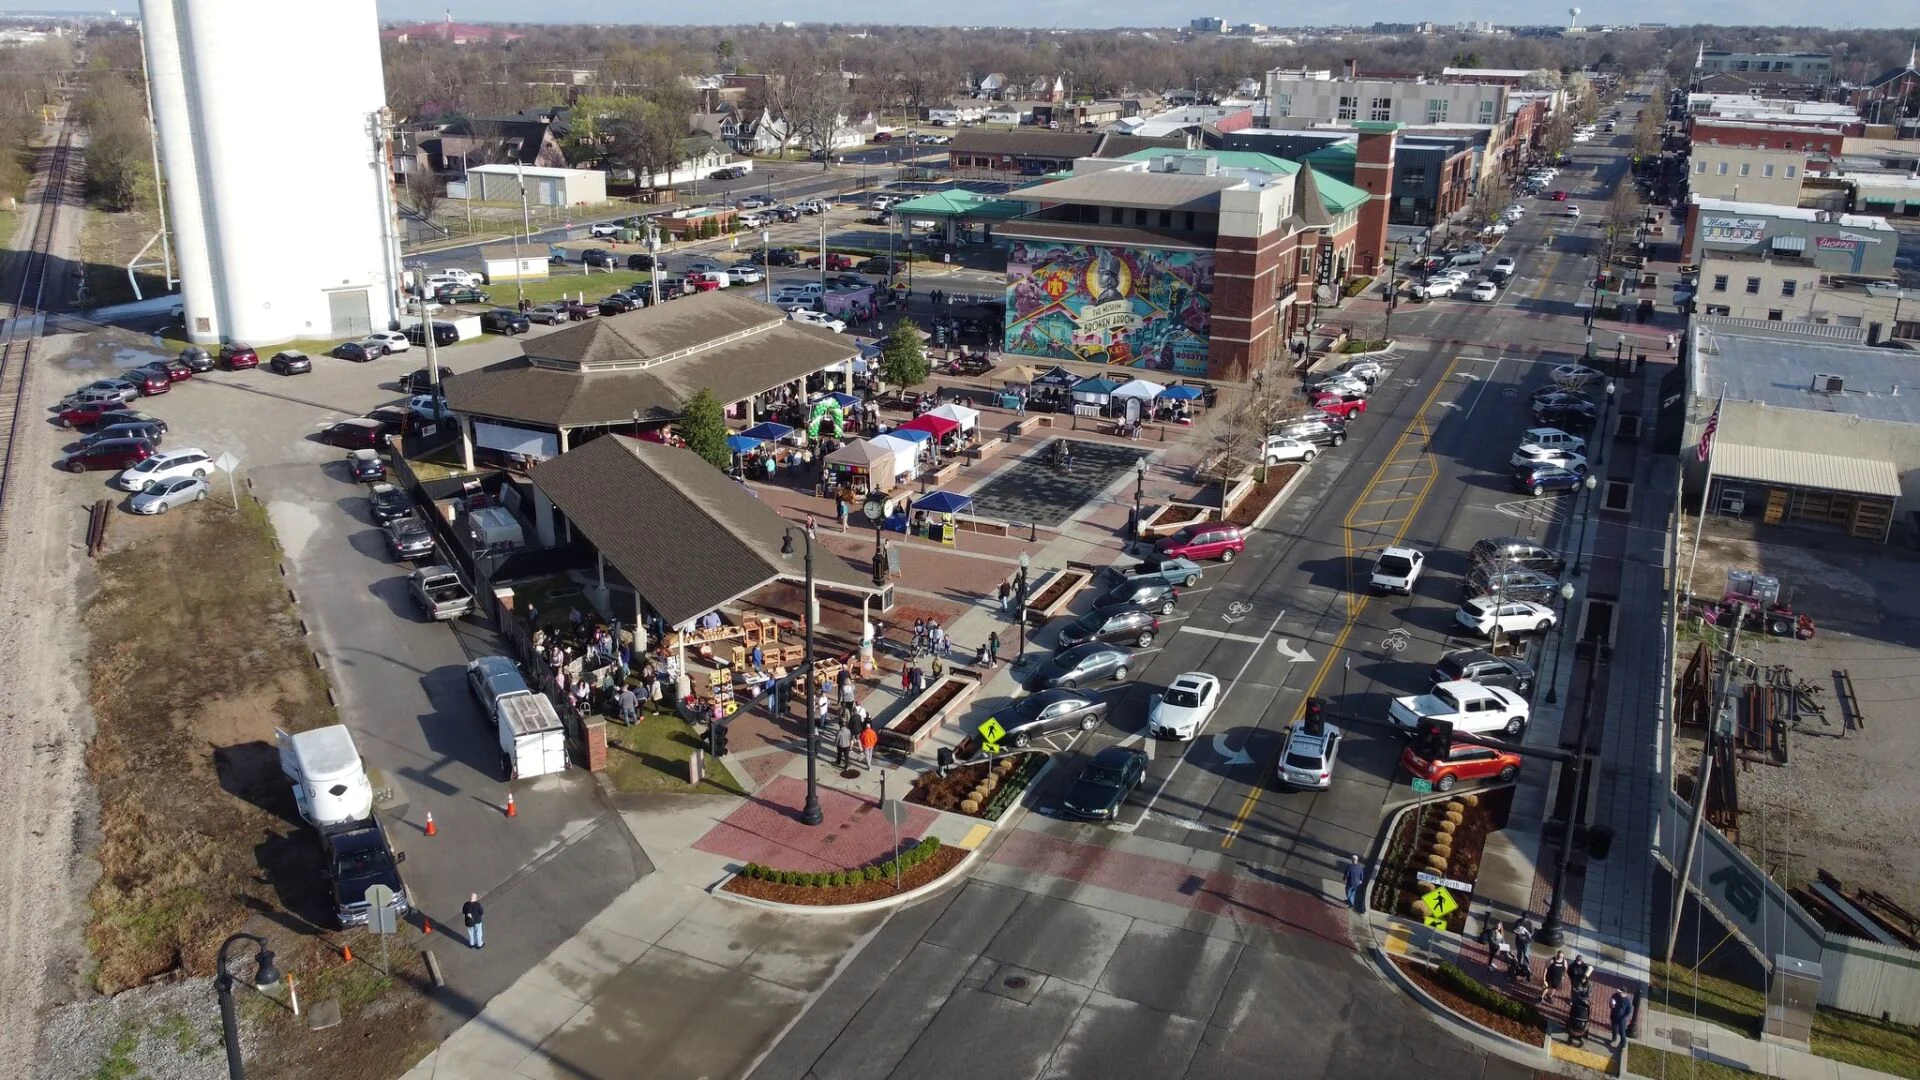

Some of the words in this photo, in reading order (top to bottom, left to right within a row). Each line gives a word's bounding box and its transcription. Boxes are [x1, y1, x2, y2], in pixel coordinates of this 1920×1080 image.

[1707, 217, 1730, 226] Main
[1737, 219, 1760, 228] Street
[1819, 238, 1856, 248] SHOPPES
[1321, 245, 1331, 284] MUSEUM
[1093, 308, 1102, 316] THE
[1084, 317, 1110, 334] BROKEN
[1113, 314, 1135, 325] ARROW
[1439, 878, 1460, 888] Worth
